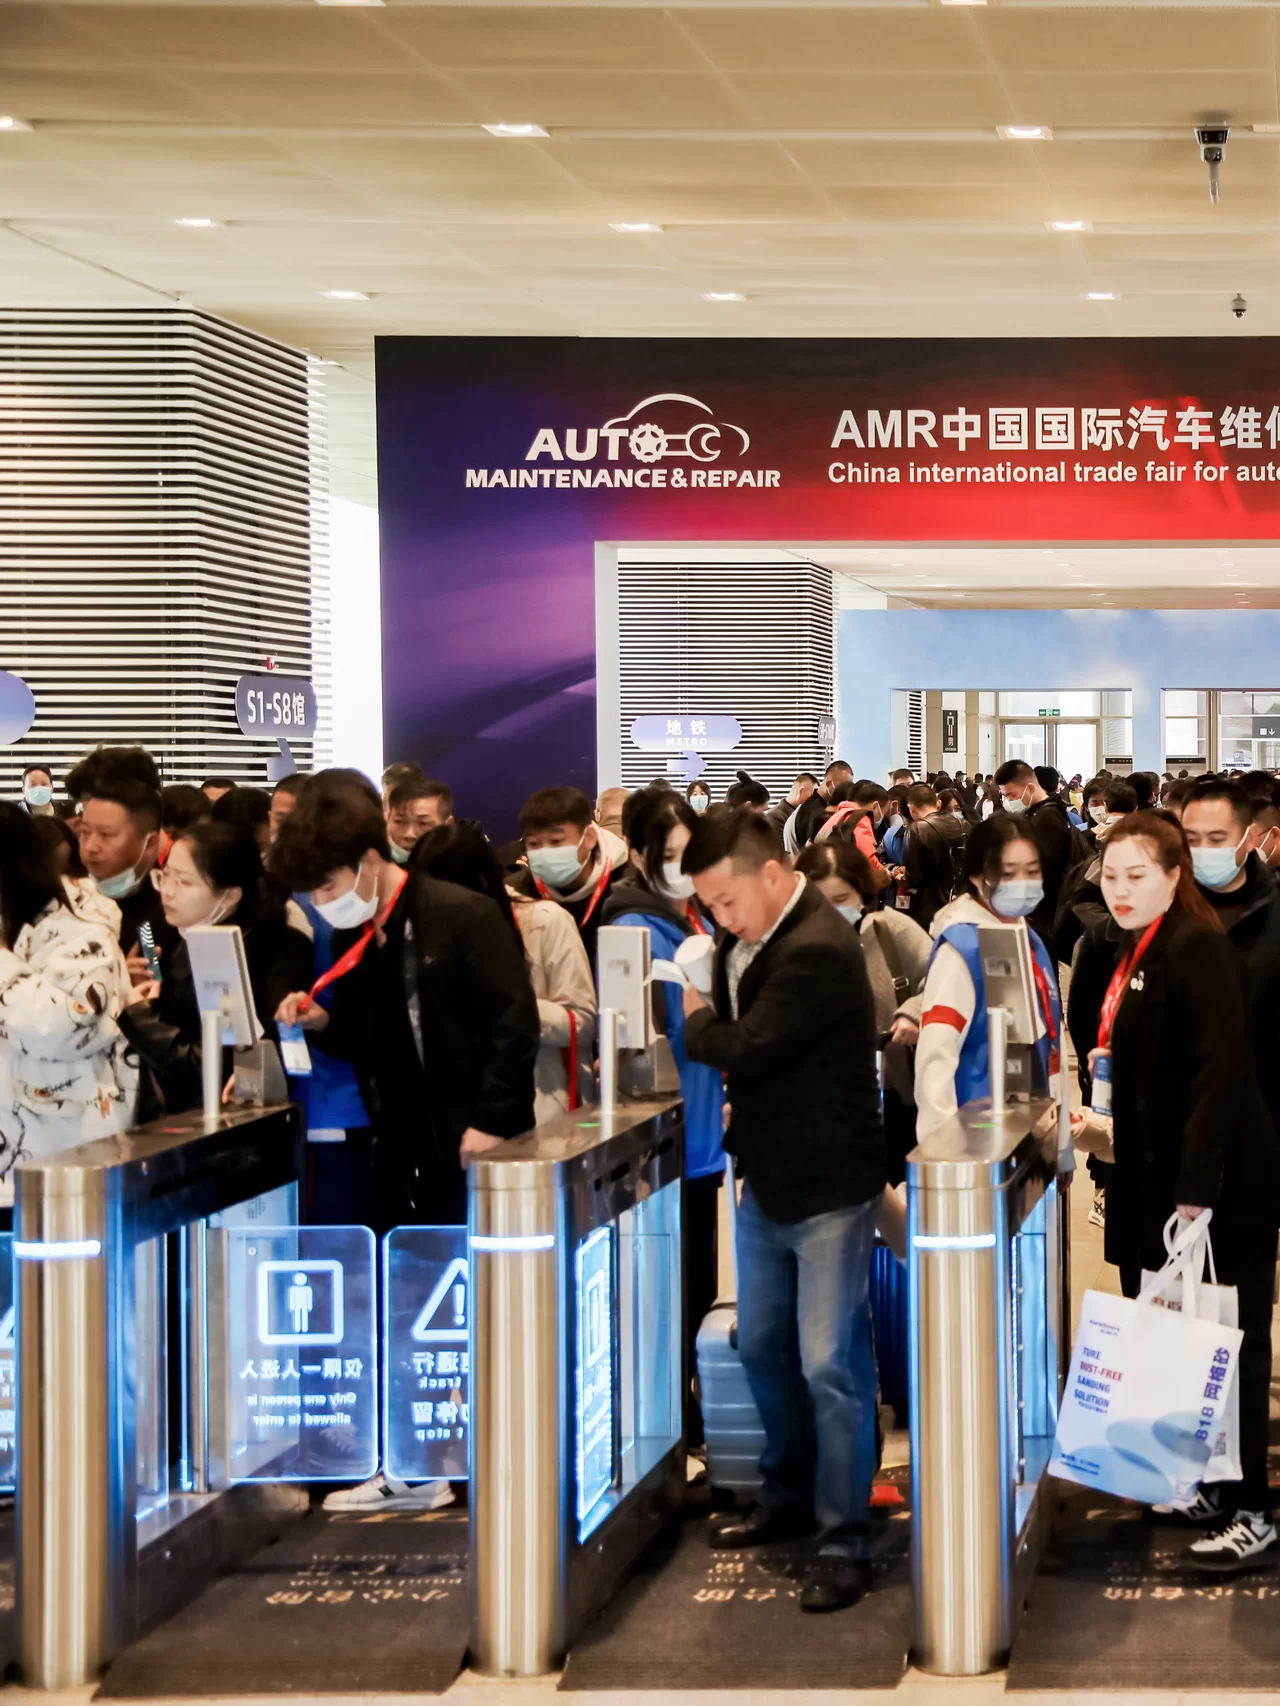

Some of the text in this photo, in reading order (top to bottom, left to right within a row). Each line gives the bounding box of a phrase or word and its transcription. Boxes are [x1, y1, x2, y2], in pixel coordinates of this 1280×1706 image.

[828, 462, 901, 483] China
[909, 461, 1065, 482] international
[1073, 461, 1138, 482] trade
[1145, 460, 1187, 482] fair
[1193, 460, 1230, 482] for
[247, 689, 306, 726] S1-S8馆
[665, 719, 708, 736] 地铁
[666, 738, 708, 746] METRO
[1080, 1361, 1123, 1382] DUST-FREE
[1077, 1375, 1111, 1393] SANDING
[1074, 1388, 1110, 1408] SOLUTION
[1195, 1406, 1215, 1441] 818
